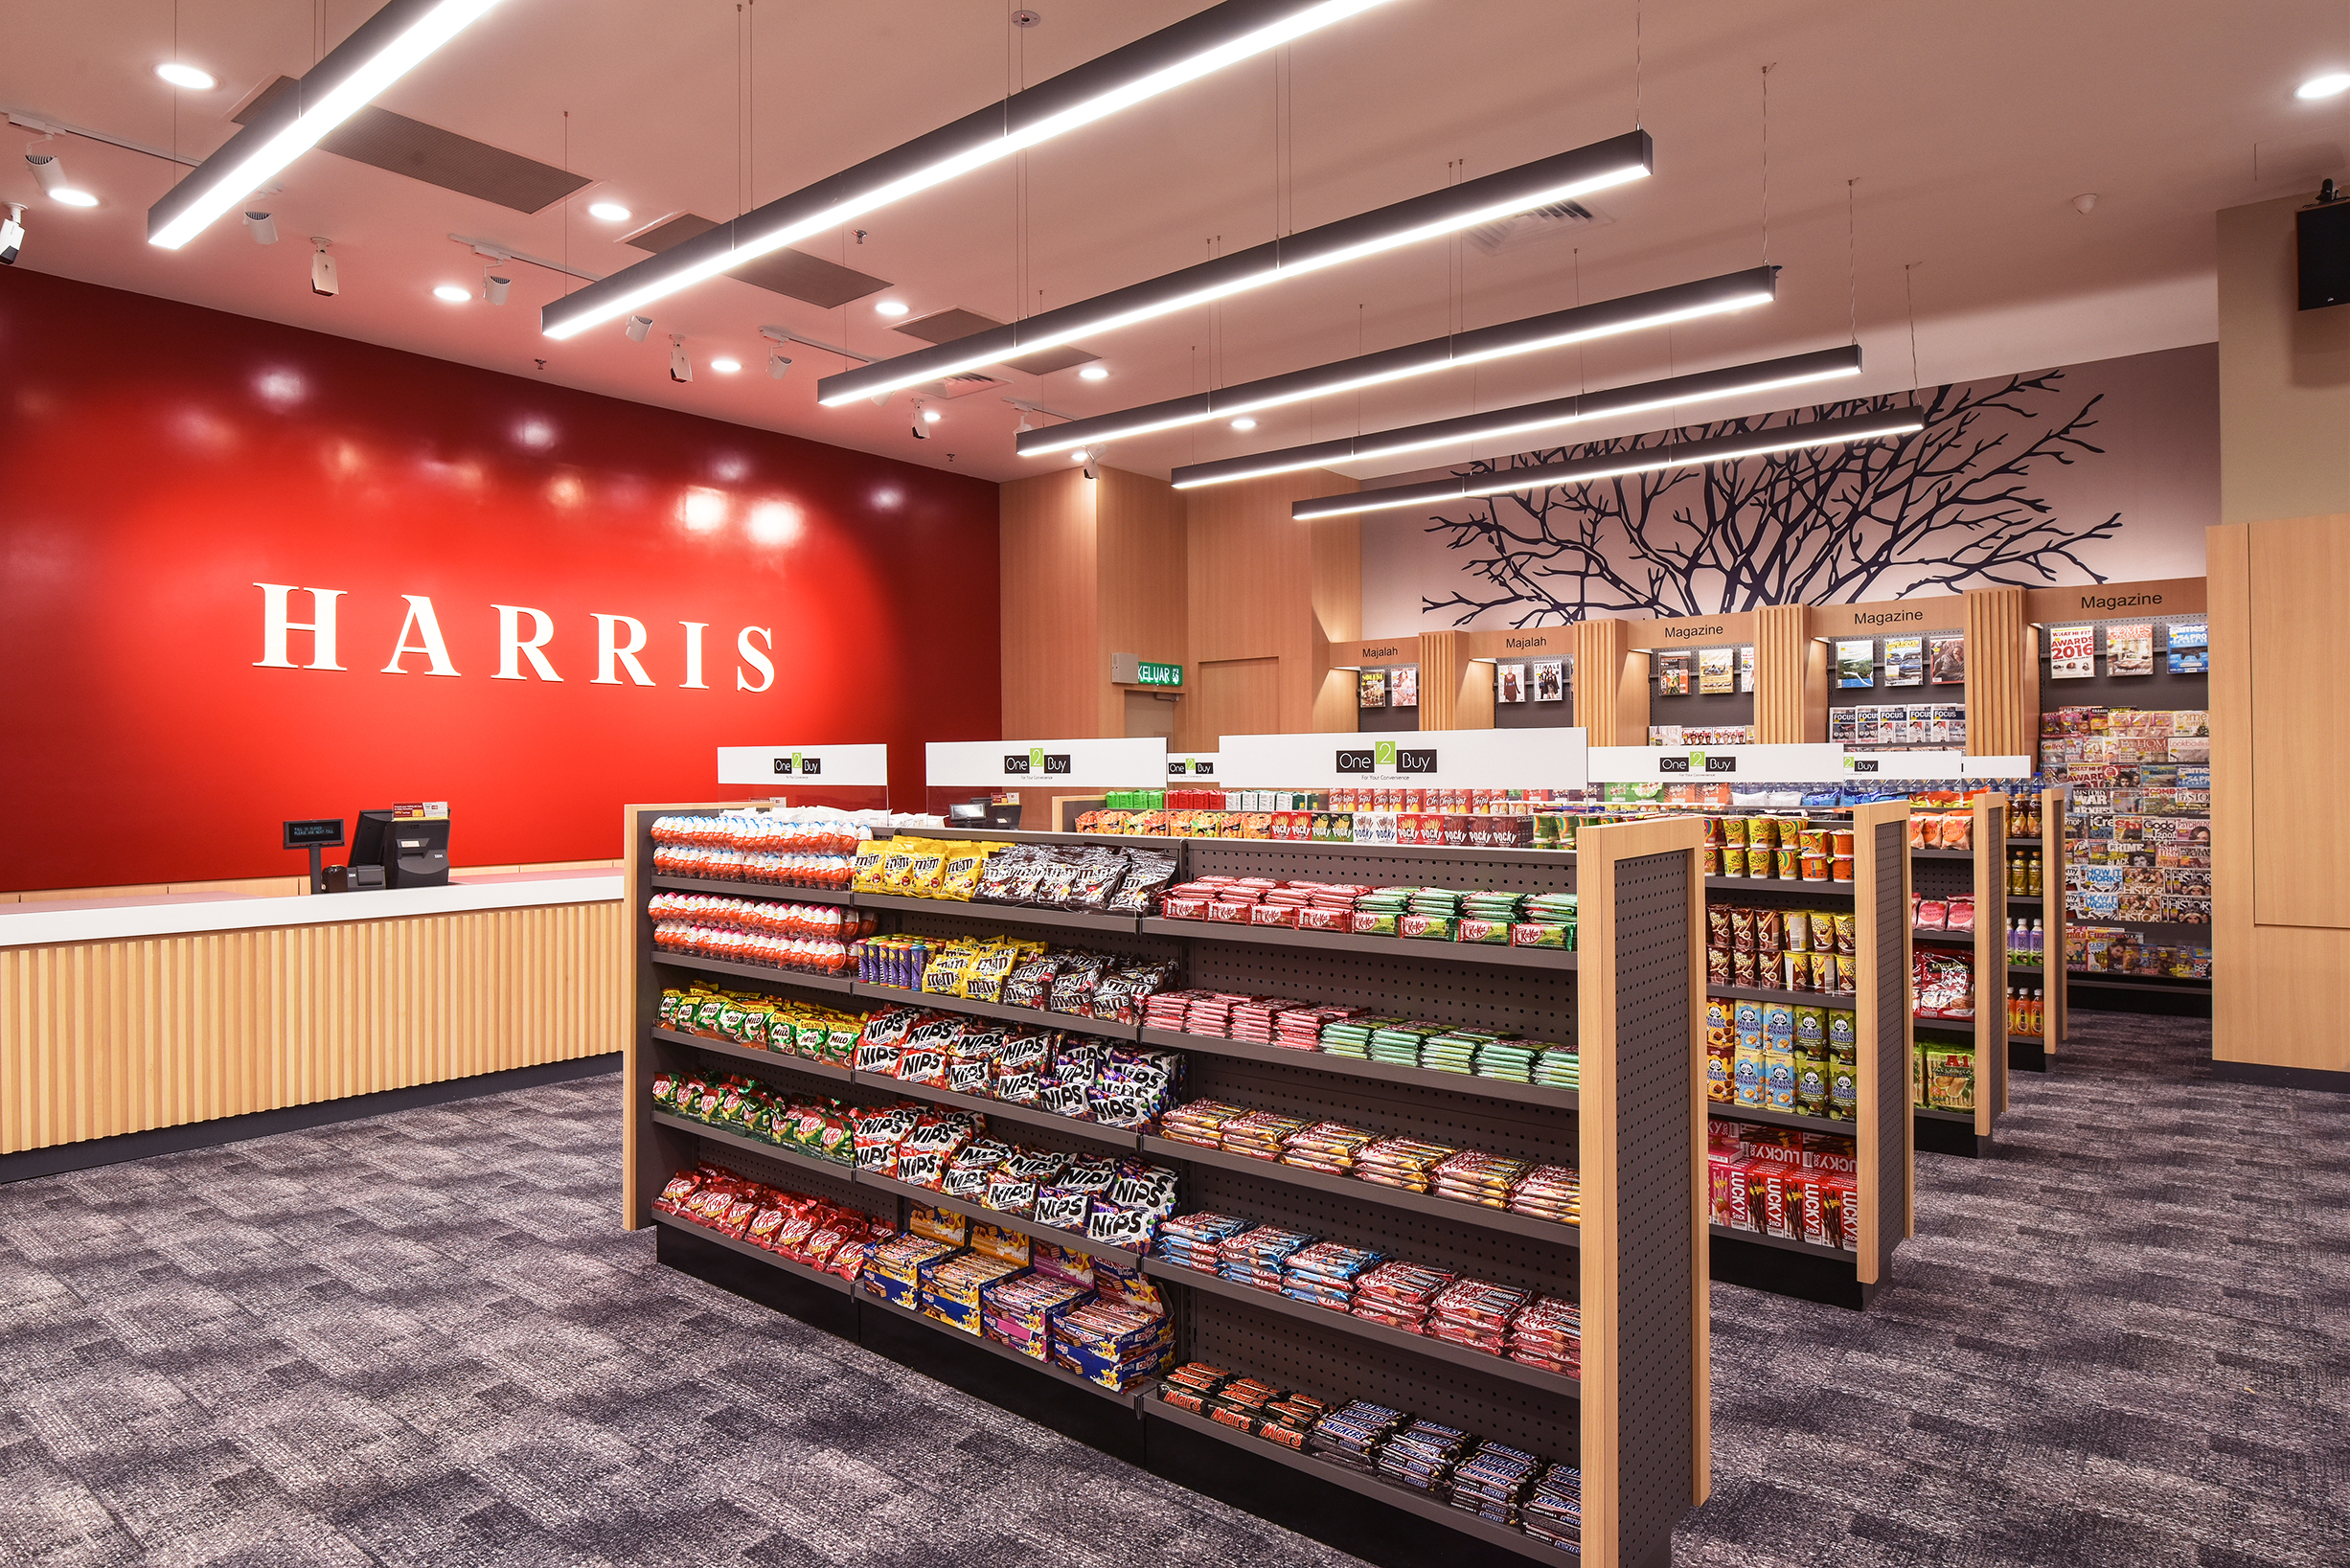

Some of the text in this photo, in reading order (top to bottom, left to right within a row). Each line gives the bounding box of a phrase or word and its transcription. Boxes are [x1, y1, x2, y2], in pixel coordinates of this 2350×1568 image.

[2080, 593, 2163, 612] Magazine
[1854, 609, 1924, 625] Magazine
[252, 581, 776, 693] HARRIS
[1665, 625, 1723, 639] Magazine
[1506, 637, 1547, 650] Majalah
[2052, 636, 2093, 648] AWARDS
[2052, 643, 2093, 660] 2016
[1362, 647, 1399, 659] Majalah
[1138, 666, 1170, 681] KELUAR
[776, 753, 818, 774] One 2 Buy
[1006, 749, 1066, 773] One 2 Buy
[1170, 759, 1211, 774] One 2 Buy
[1339, 742, 1430, 772] One 2 Buy
[1662, 752, 1731, 771] One 2 Buy
[1844, 757, 1875, 772] 2 Buy
[2074, 796, 2107, 805] WAR
[2108, 843, 2144, 852] CRIME
[746, 1016, 762, 1025] MILO
[867, 1017, 903, 1040] NIPS
[773, 1028, 788, 1036] MILO
[830, 1035, 848, 1045] MILO
[859, 1046, 900, 1066] NIPS
[1003, 1036, 1044, 1061] NIPS
[901, 1055, 941, 1076] NIPS
[1945, 1055, 1971, 1068] A1
[950, 1063, 986, 1082] NIPS
[999, 1073, 1039, 1096] NIPS
[1041, 1085, 1083, 1109] NIPS
[1092, 1099, 1137, 1121] NIPS
[1755, 1145, 1800, 1165] LUCKY
[899, 1154, 936, 1177] NIPS
[1116, 1179, 1162, 1208] NIPS
[1731, 1170, 1745, 1216] LUCKY
[1767, 1177, 1783, 1222] LUCKY
[1038, 1197, 1083, 1221] NIPS
[1805, 1183, 1820, 1230] LUCKY
[1093, 1212, 1142, 1237] NIPS
[1405, 1276, 1434, 1289] CHUNKY
[1490, 1290, 1520, 1302] CHUNKY
[1168, 1373, 1211, 1389] Mars
[1164, 1390, 1202, 1412] Mars
[1211, 1407, 1251, 1430] Mars
[1260, 1422, 1304, 1447] Mars
[1323, 1421, 1365, 1441] SNICKERS
[1407, 1462, 1430, 1474] SNICKERS
[1472, 1462, 1519, 1479] SNICKERS
[1480, 1454, 1528, 1472] SNICKERS
[1483, 1487, 1507, 1500] SNICKERS
